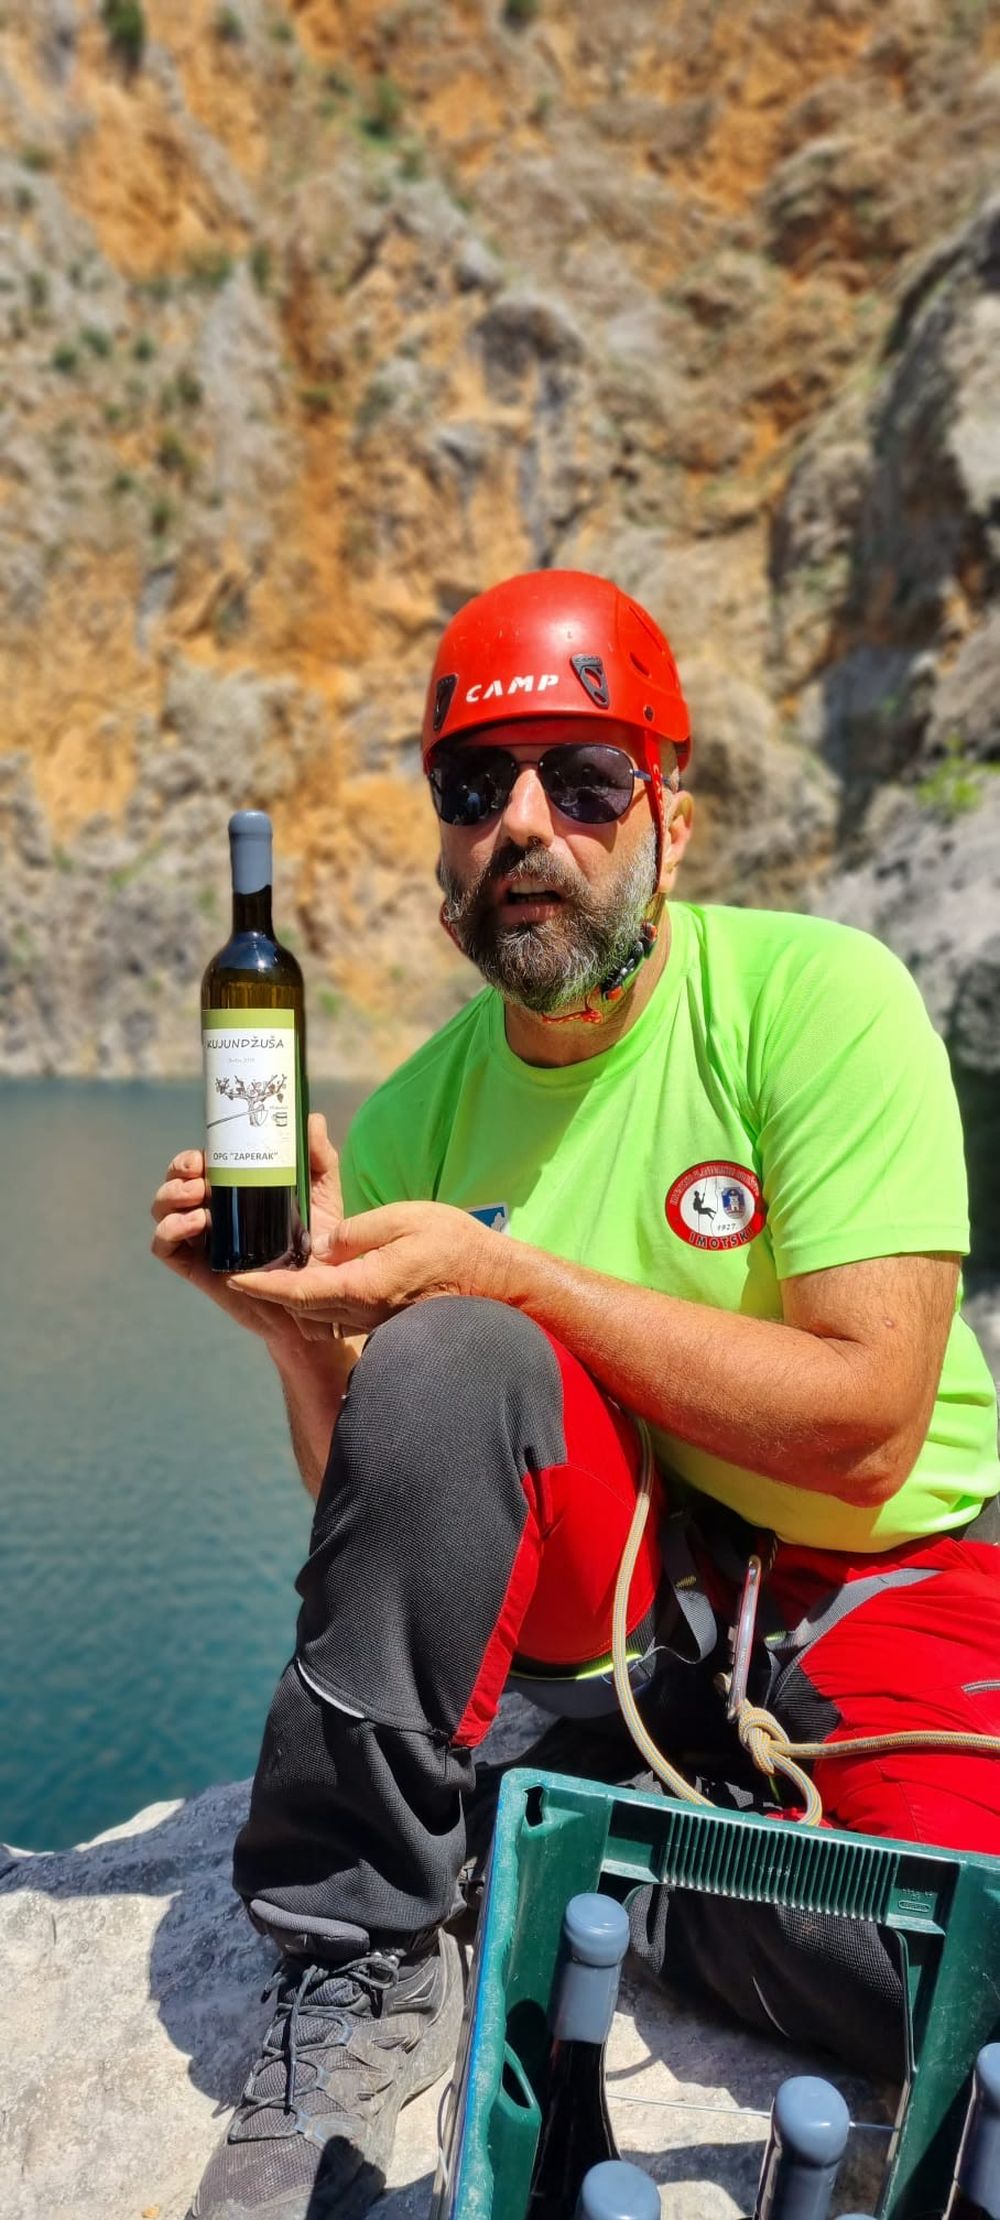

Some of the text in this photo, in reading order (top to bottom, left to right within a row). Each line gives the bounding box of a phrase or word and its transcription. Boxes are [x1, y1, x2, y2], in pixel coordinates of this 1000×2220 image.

[465, 674, 560, 703] CAMP
[213, 1152, 278, 1161] OPG "ZAPERAK"
